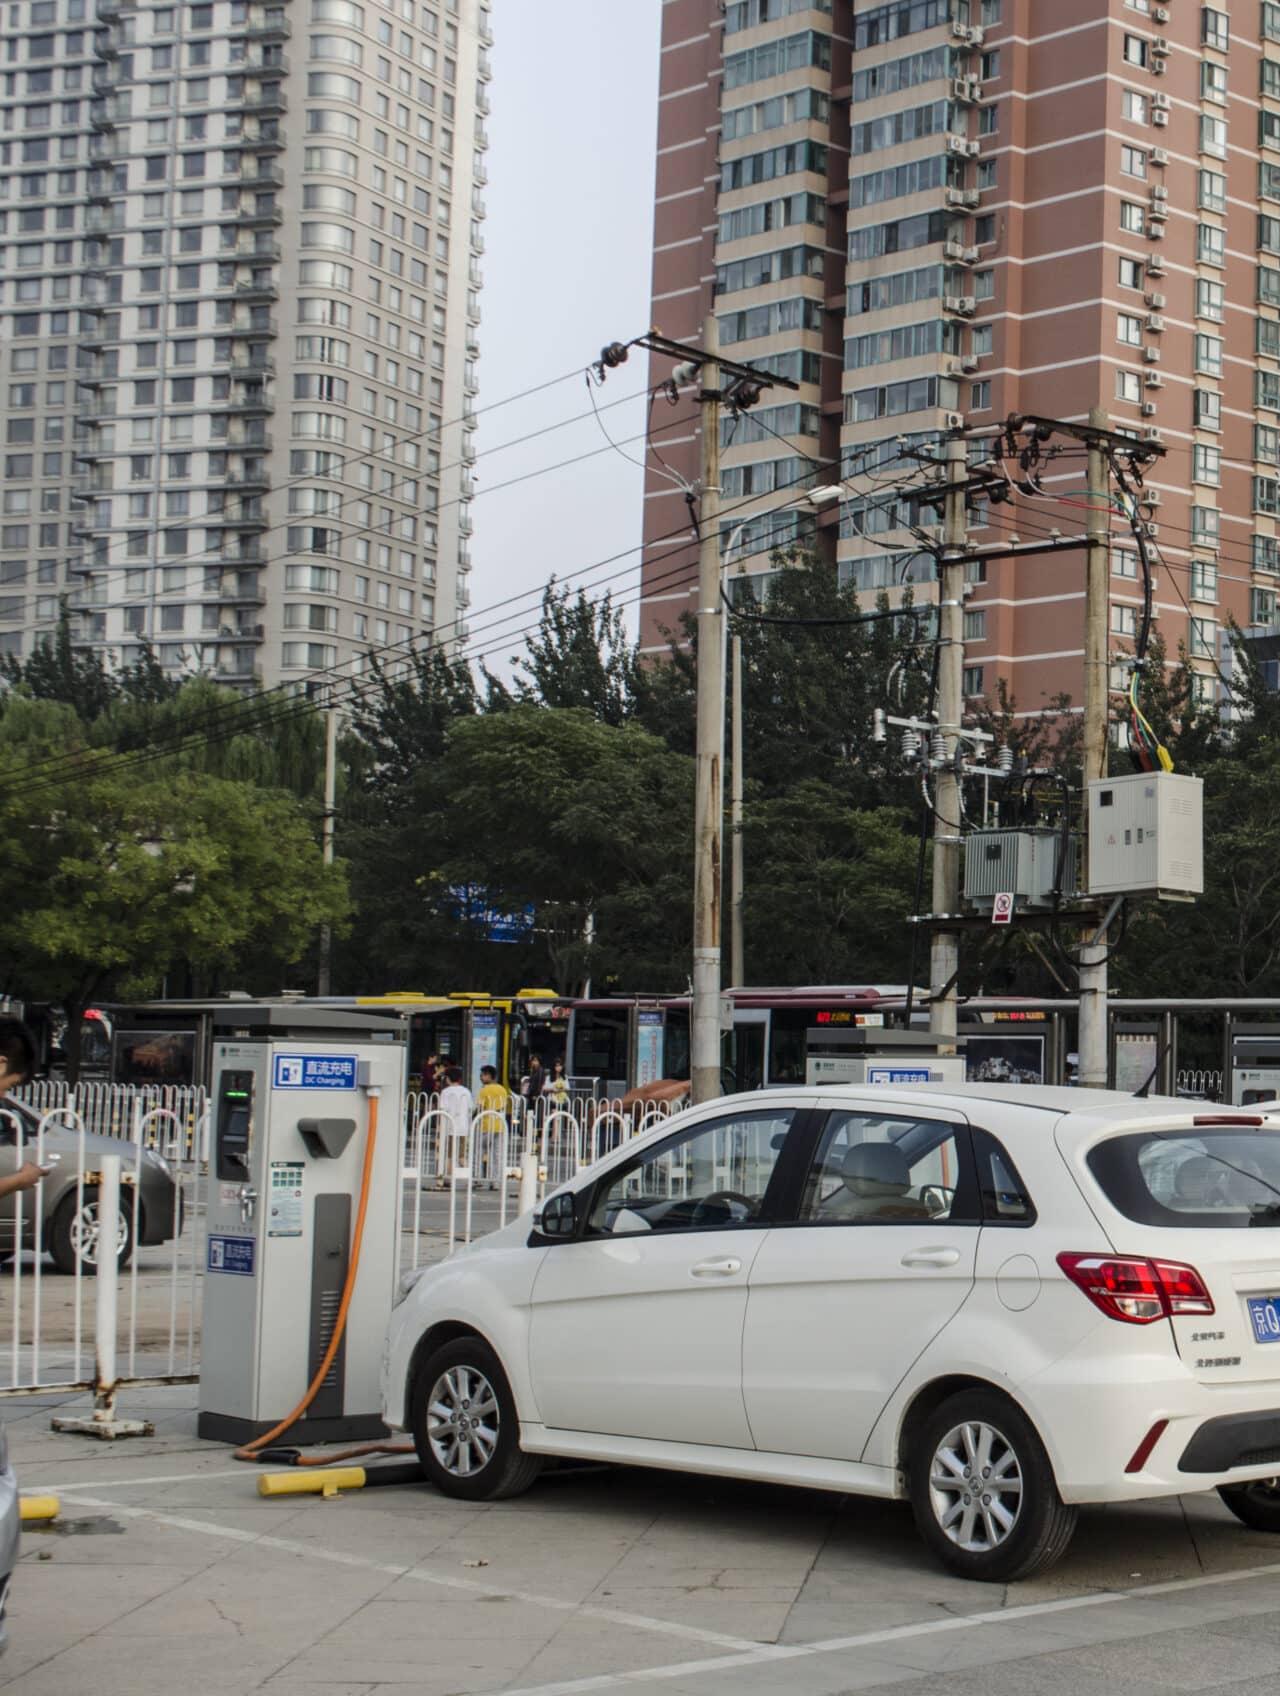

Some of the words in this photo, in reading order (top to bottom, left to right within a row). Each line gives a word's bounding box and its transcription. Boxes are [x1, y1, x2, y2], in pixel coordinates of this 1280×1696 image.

[306, 1061, 352, 1076] 直流充电
[316, 1077, 345, 1086] Charging
